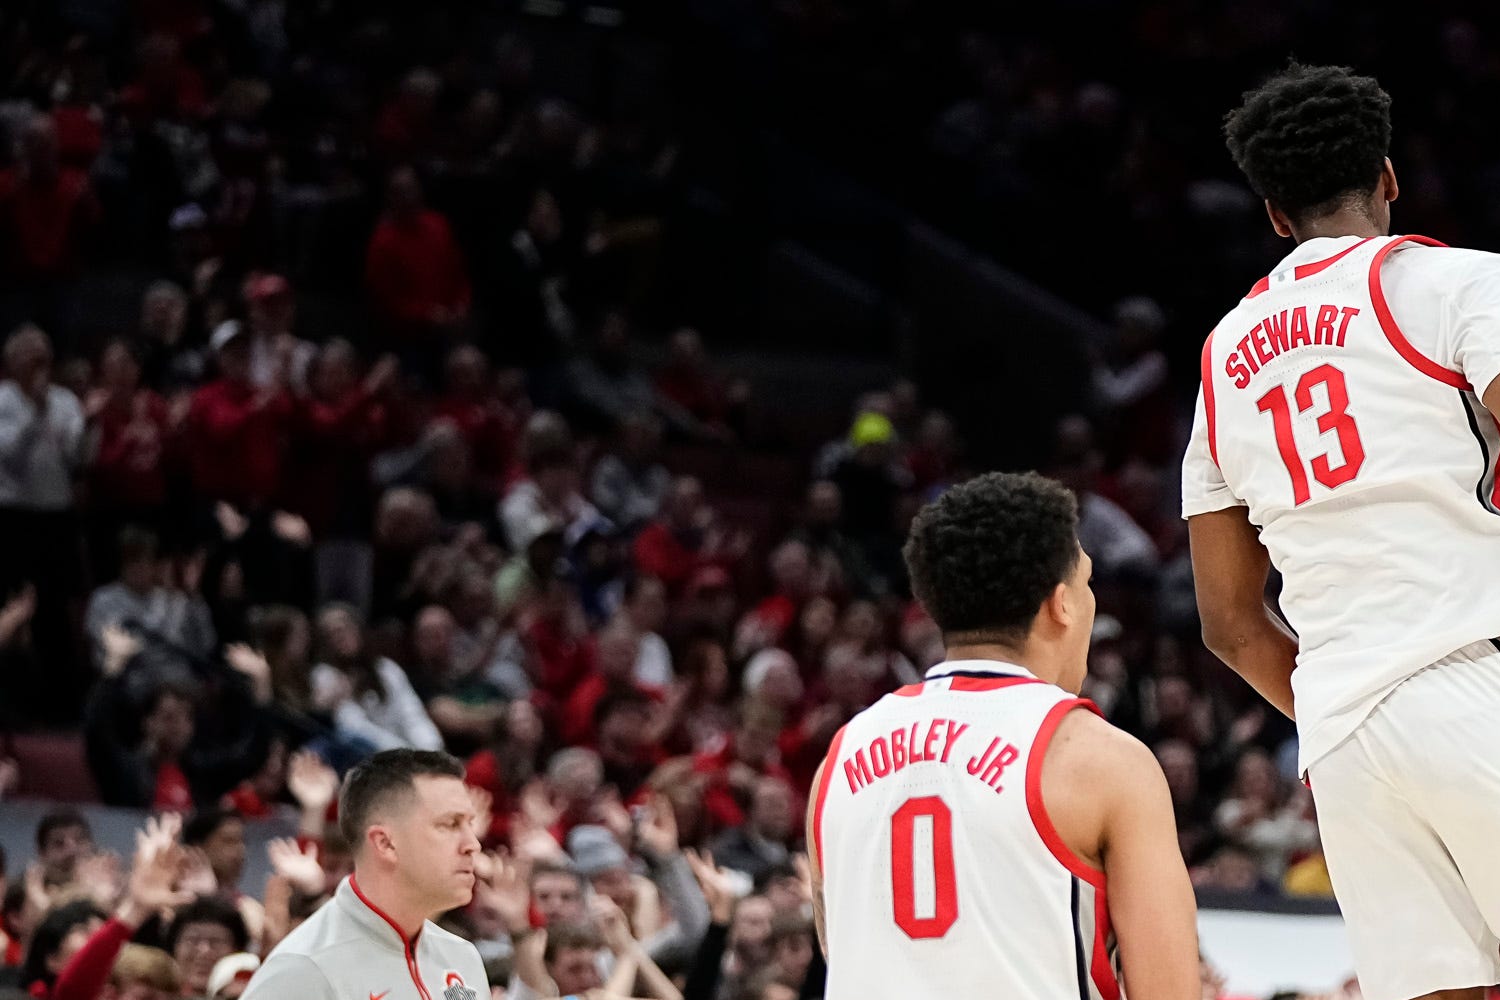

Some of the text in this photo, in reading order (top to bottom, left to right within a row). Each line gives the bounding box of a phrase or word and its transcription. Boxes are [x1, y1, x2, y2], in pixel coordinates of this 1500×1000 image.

[1225, 305, 1360, 389] STEWART
[1256, 363, 1366, 507] 13
[843, 718, 1020, 795] MOBLEY JR.
[891, 795, 959, 941] 0
